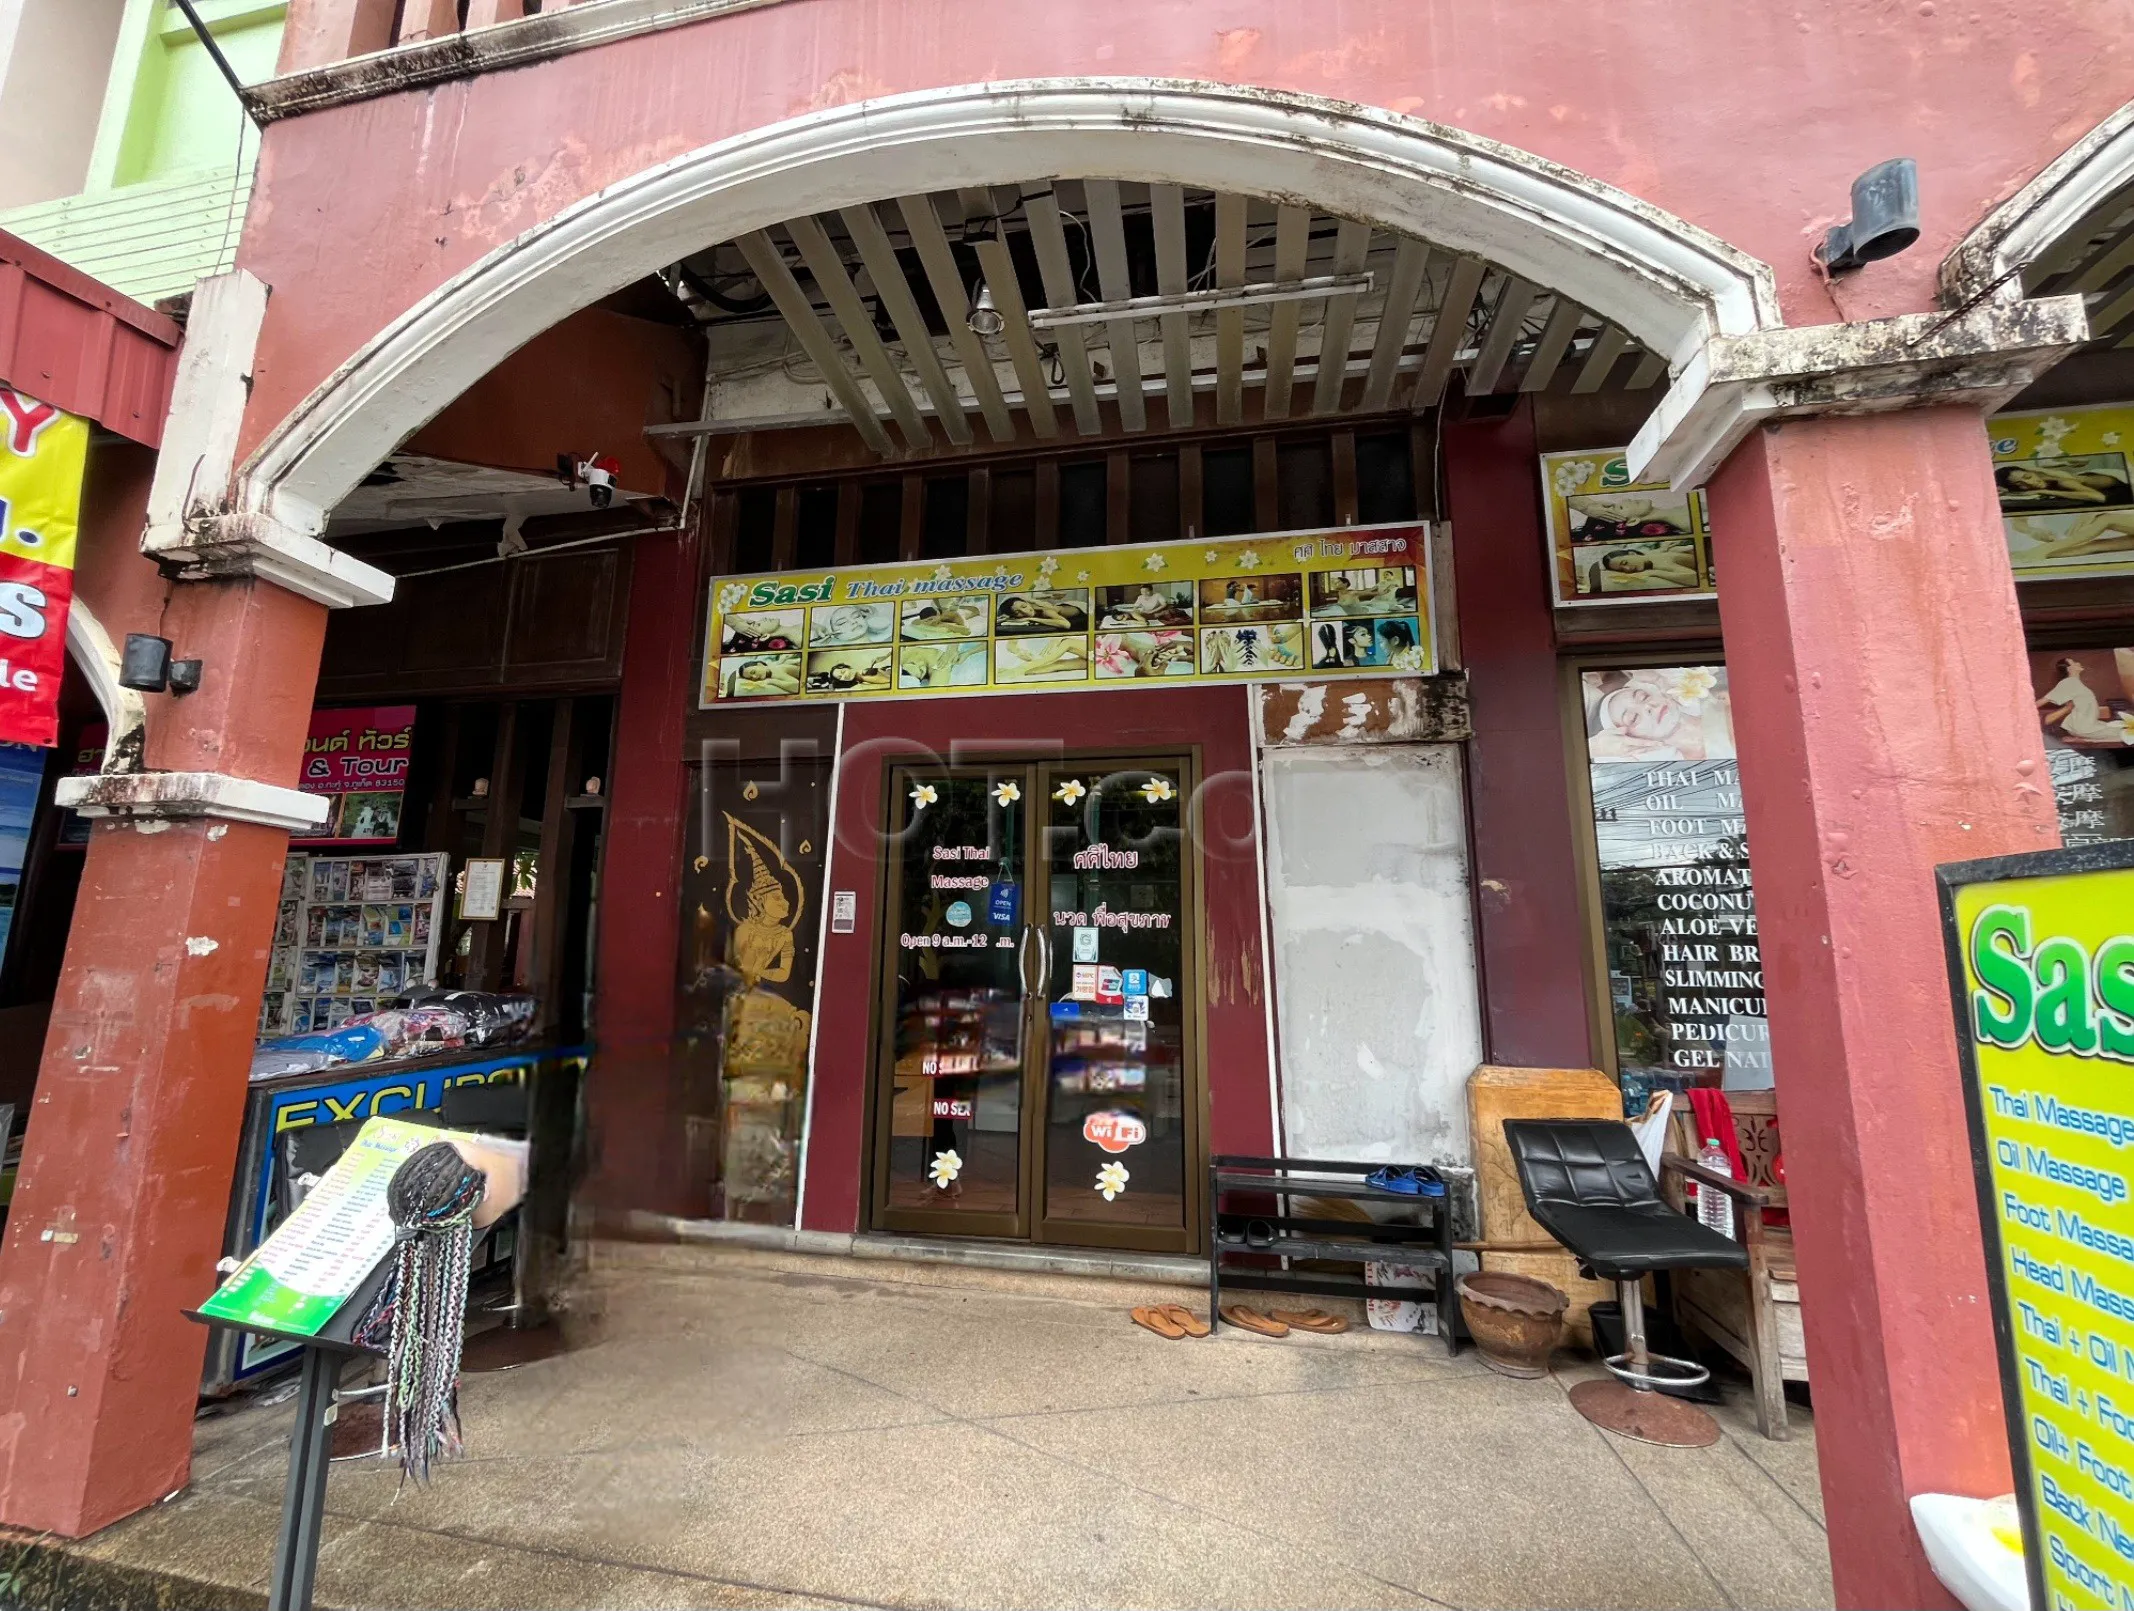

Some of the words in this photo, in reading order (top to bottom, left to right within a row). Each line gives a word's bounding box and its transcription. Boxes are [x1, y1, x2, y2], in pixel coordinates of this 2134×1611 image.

[748, 576, 836, 607] Sasi
[846, 580, 904, 599] Thai
[911, 573, 1023, 594] massage
[307, 758, 331, 777] &
[340, 756, 409, 777] Tour
[1644, 770, 1699, 787] THAI
[1646, 795, 1683, 810] OIL
[1650, 819, 1707, 835] FOOT
[933, 846, 961, 860] Sasi
[963, 846, 991, 860] Thai
[1653, 842, 1714, 859] BACK
[1719, 843, 1735, 859] &
[931, 874, 990, 890] Massage
[992, 912, 1011, 921] VISA
[1661, 918, 1722, 936] ALOE
[1728, 918, 1758, 936] VE
[901, 933, 931, 949] Open
[932, 934, 941, 948] 9
[1662, 944, 1719, 961] HAIR
[1729, 944, 1761, 962] BR
[1969, 903, 2134, 1063] Sas
[922, 1061, 938, 1075] NO
[1674, 1049, 1721, 1068] GEL
[933, 1101, 949, 1116] NO
[1988, 1085, 2030, 1119] Thai
[2034, 1094, 2134, 1146] Massage
[1997, 1138, 2021, 1170] Oil
[2026, 1145, 2127, 1202] Massage
[2003, 1190, 2052, 1233] Foot
[2056, 1208, 2134, 1263] Massa
[2011, 1246, 2065, 1292] Head
[2070, 1268, 2134, 1322] Mass
[2017, 1300, 2061, 1345] Thai
[2069, 1330, 2080, 1353] +
[2089, 1334, 2118, 1373] Oil
[2024, 1357, 2069, 1405] Thai
[2077, 1389, 2089, 1415] +
[2033, 1416, 2069, 1461] Oil+
[2076, 1440, 2133, 1500] Foot
[2041, 1474, 2093, 1534] Back
[2049, 1534, 2115, 1606] Sport
